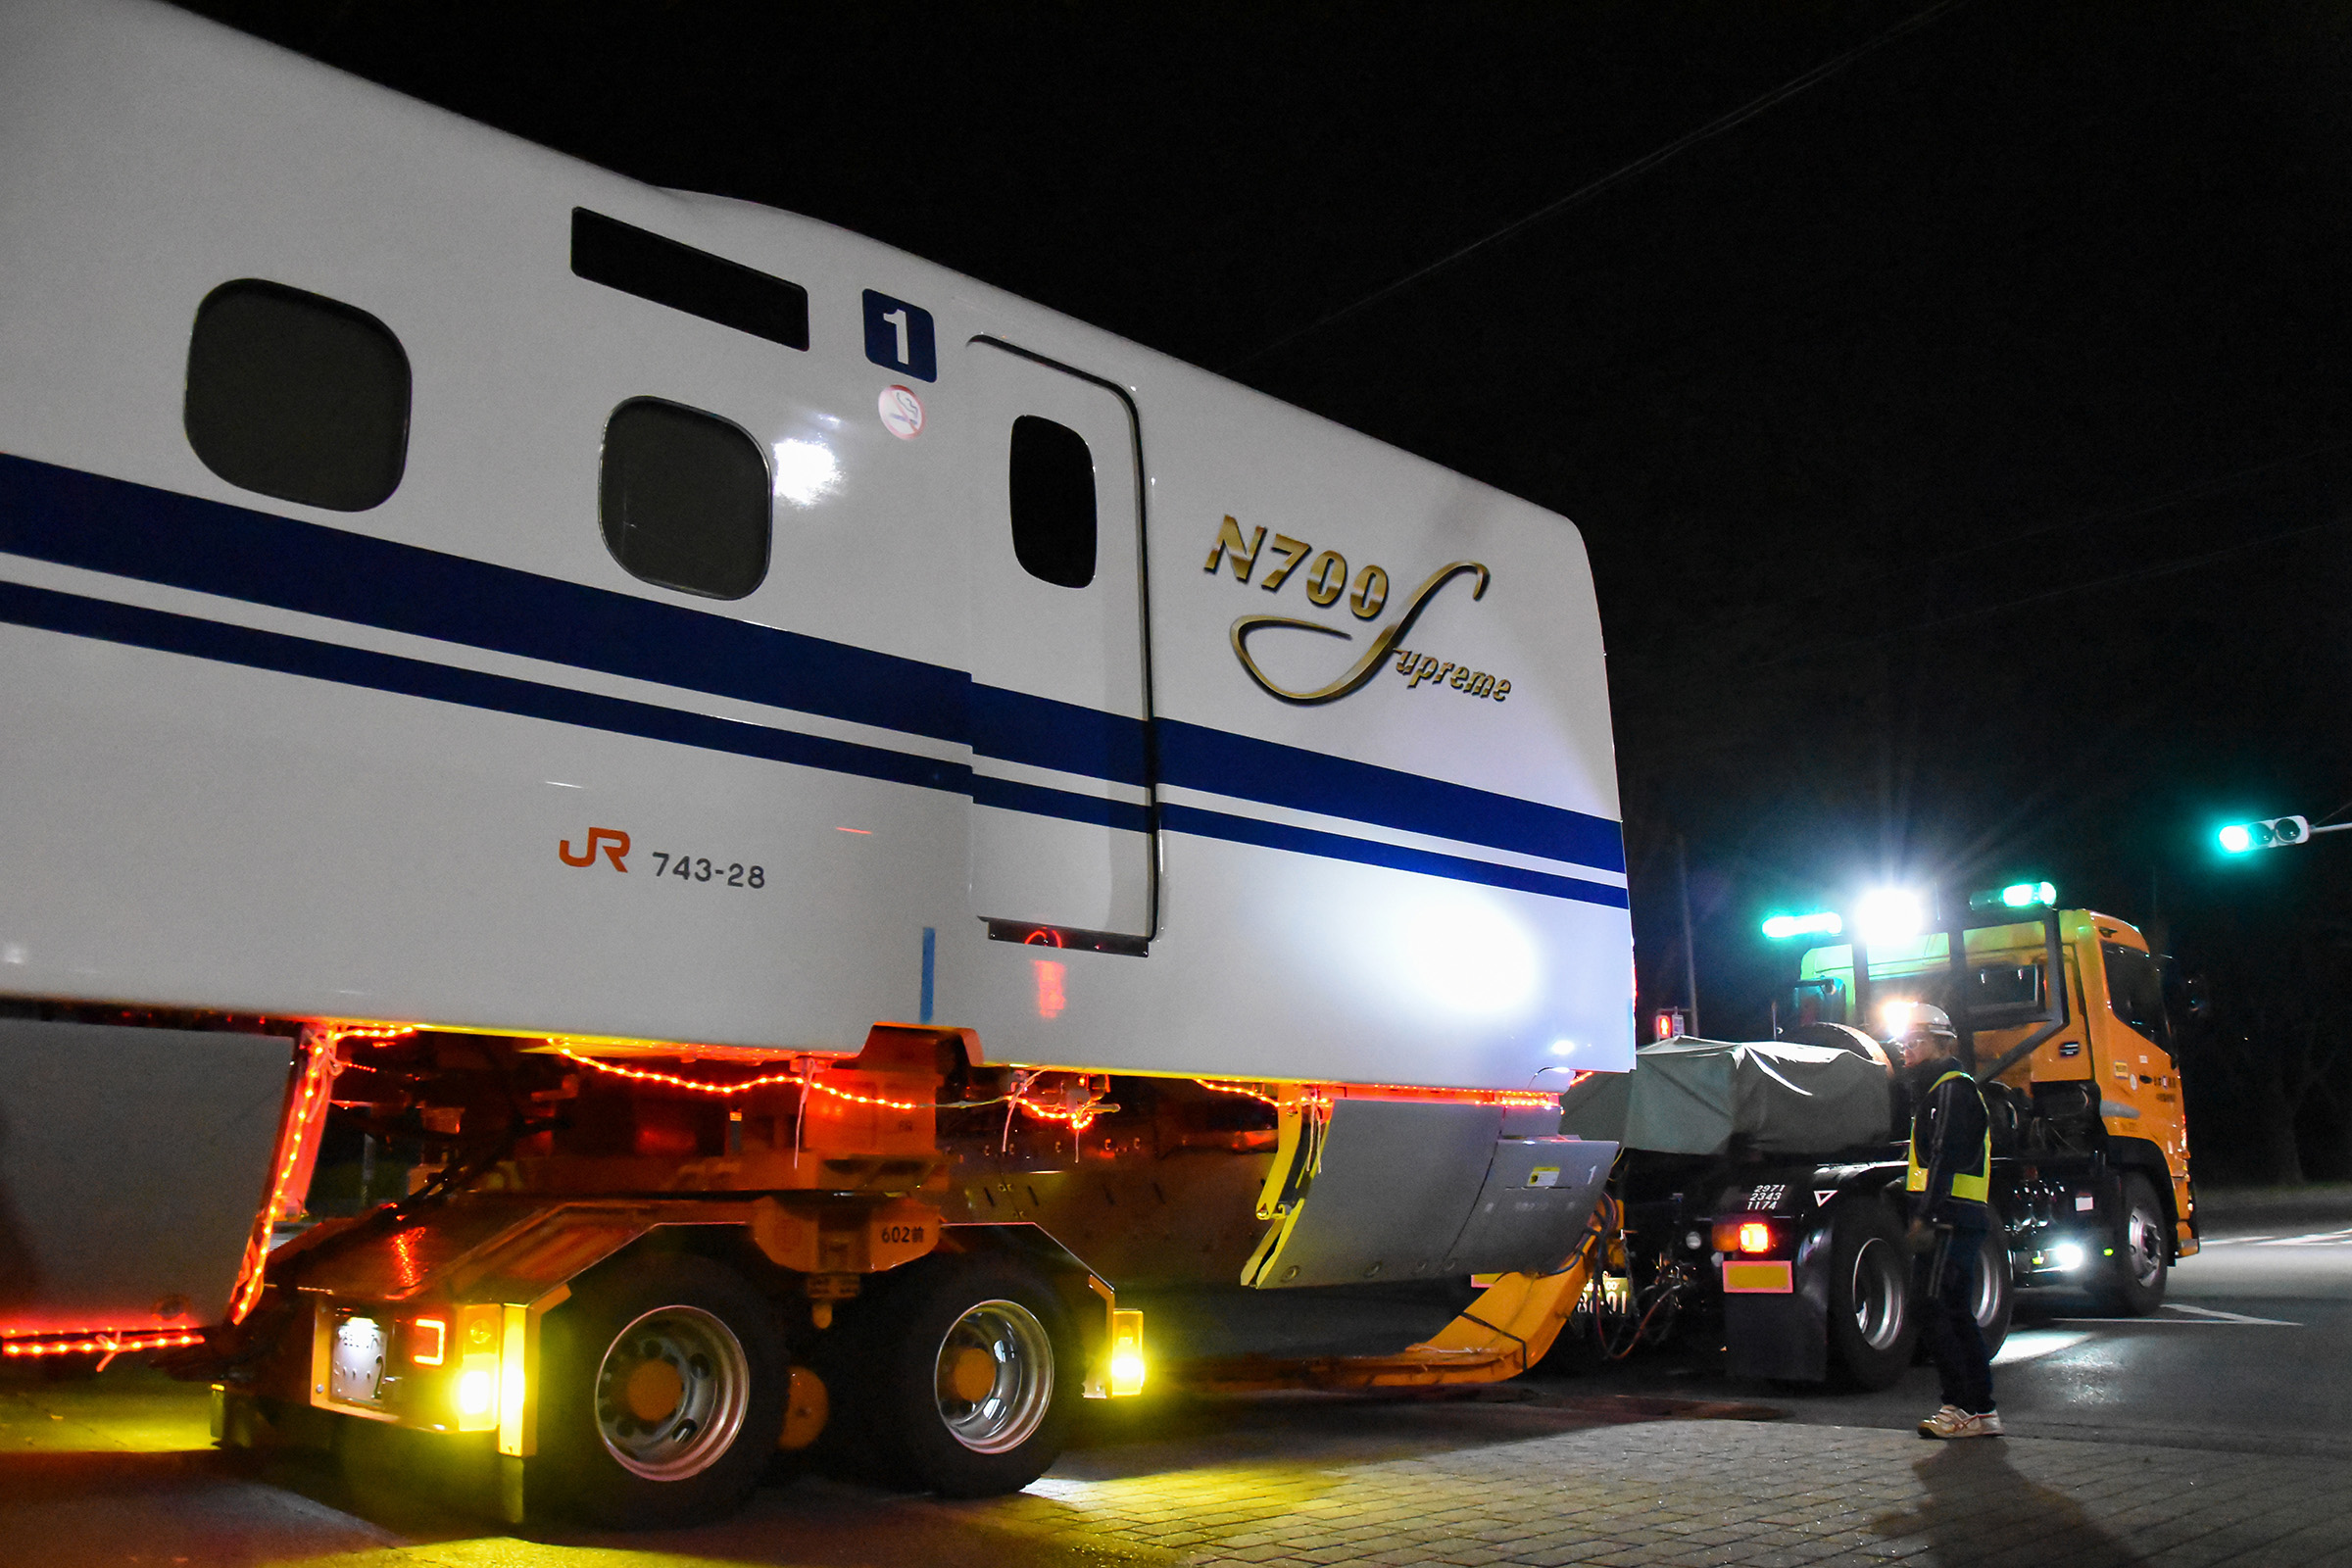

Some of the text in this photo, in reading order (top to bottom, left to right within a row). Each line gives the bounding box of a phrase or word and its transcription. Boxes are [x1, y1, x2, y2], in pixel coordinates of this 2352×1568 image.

[883, 309, 909, 366] 1
[1203, 514, 1389, 621] N700
[1229, 560, 1512, 708] Supreme
[559, 827, 765, 889] JR 743-28
[1587, 1165, 1597, 1185] 1
[1754, 1184, 1786, 1193] 2971
[1746, 1200, 1778, 1210] 1174
[1749, 1192, 1783, 1201] 2343
